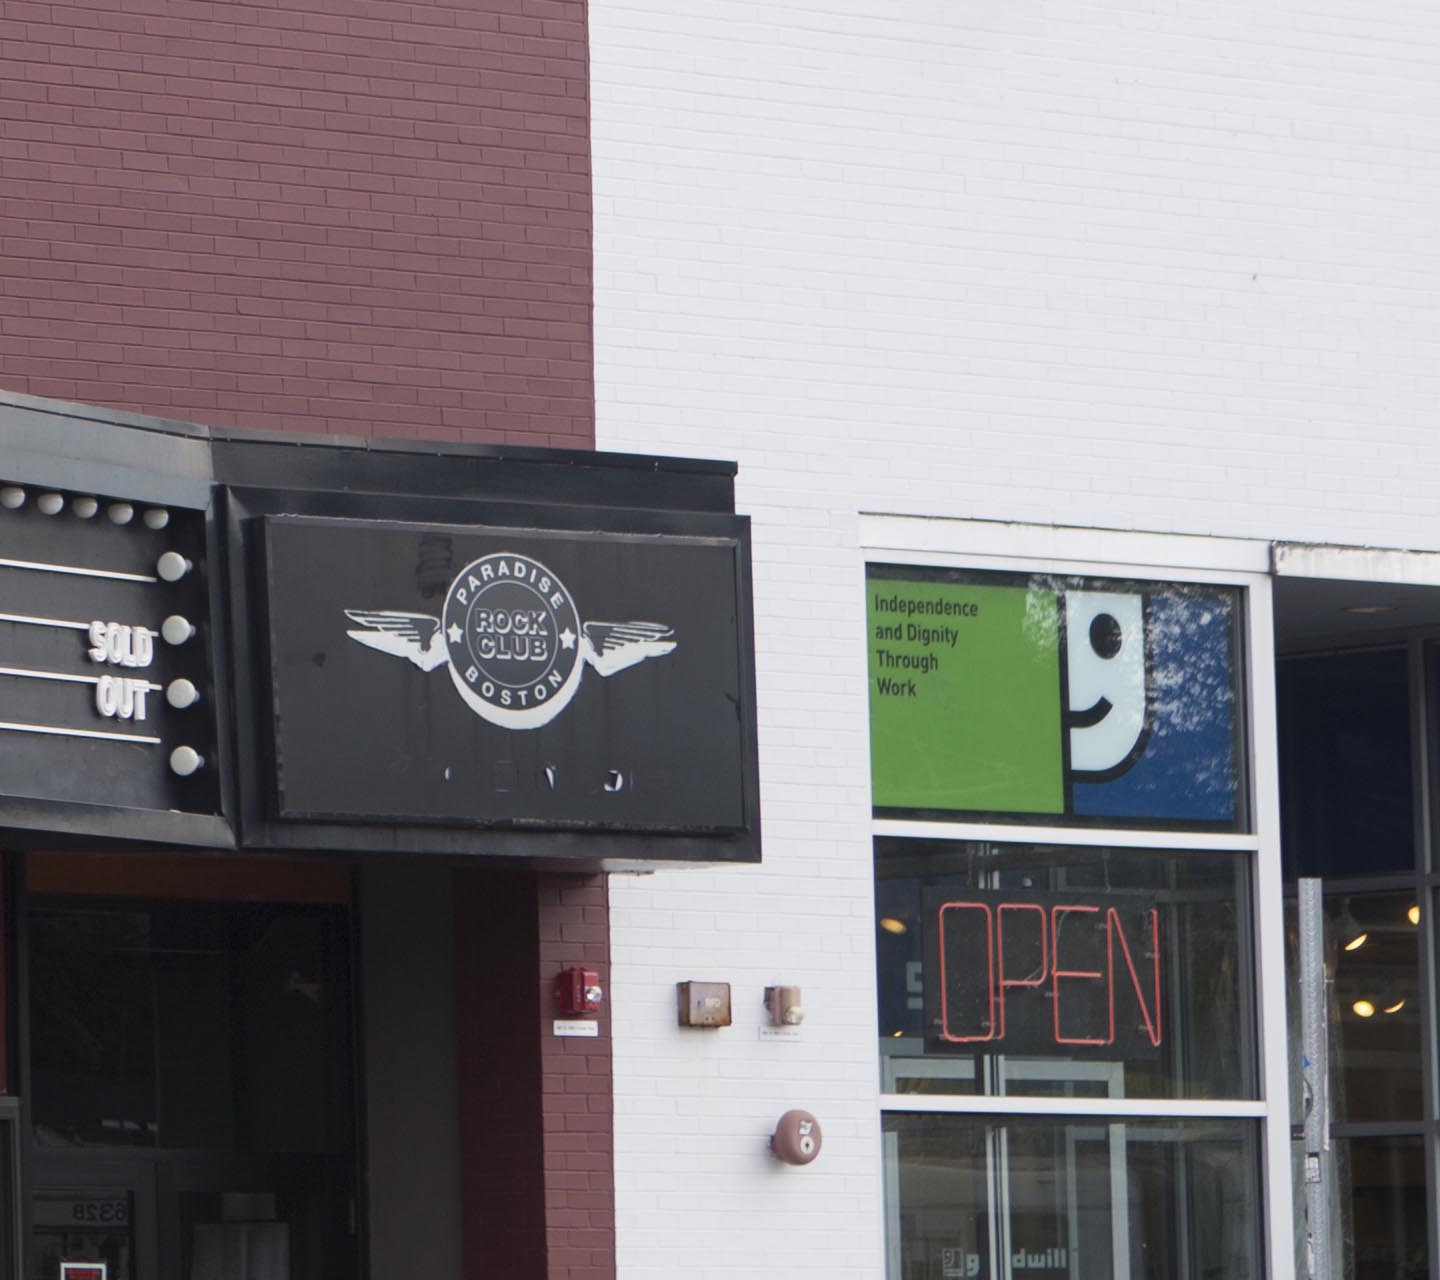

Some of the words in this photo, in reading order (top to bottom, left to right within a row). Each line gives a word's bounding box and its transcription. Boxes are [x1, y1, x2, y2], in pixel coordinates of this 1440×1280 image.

[456, 560, 564, 609] PARADISE
[875, 594, 979, 617] Independence
[475, 608, 548, 636] ROCK
[876, 624, 902, 641] and
[907, 624, 959, 647] Dignity
[88, 621, 154, 669] SOLD
[477, 634, 548, 661] CLUB
[876, 650, 938, 673] Through
[96, 675, 151, 721] OUT
[465, 666, 563, 706] BOSTON
[877, 677, 916, 697] Work
[939, 901, 1162, 1047] OPEN
